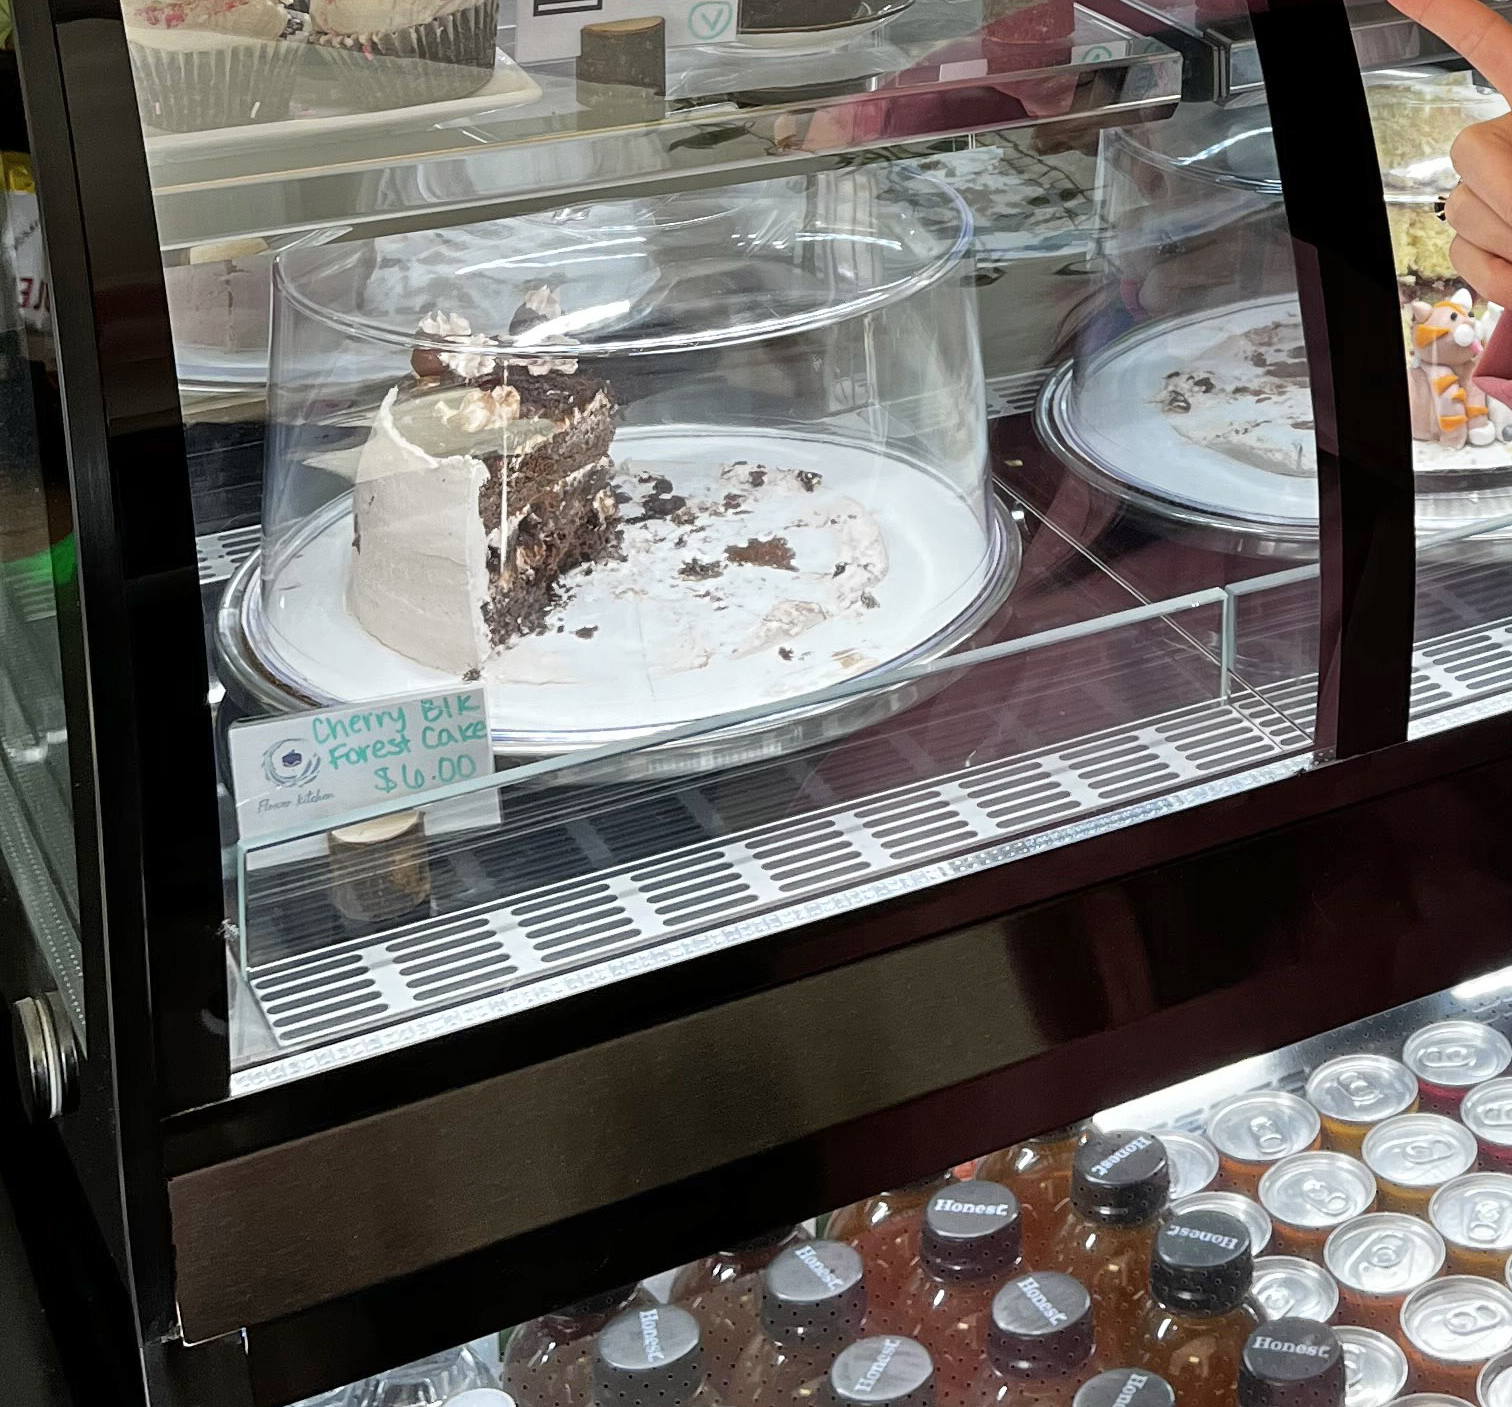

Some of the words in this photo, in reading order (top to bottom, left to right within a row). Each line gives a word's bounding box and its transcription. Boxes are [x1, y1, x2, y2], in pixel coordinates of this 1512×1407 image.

[313, 706, 406, 744] Cherry
[328, 734, 411, 770] Forest
[421, 720, 487, 750] Cake
[374, 753, 477, 793] $6.00
[1091, 1136, 1152, 1176] Honest
[935, 1198, 1009, 1217] Honest
[1167, 1225, 1239, 1250] Honest
[795, 1245, 845, 1291] Honest
[1017, 1277, 1068, 1327] Honest
[639, 1309, 665, 1362] Honest
[1253, 1336, 1330, 1359] Honest
[853, 1338, 901, 1393] Honest
